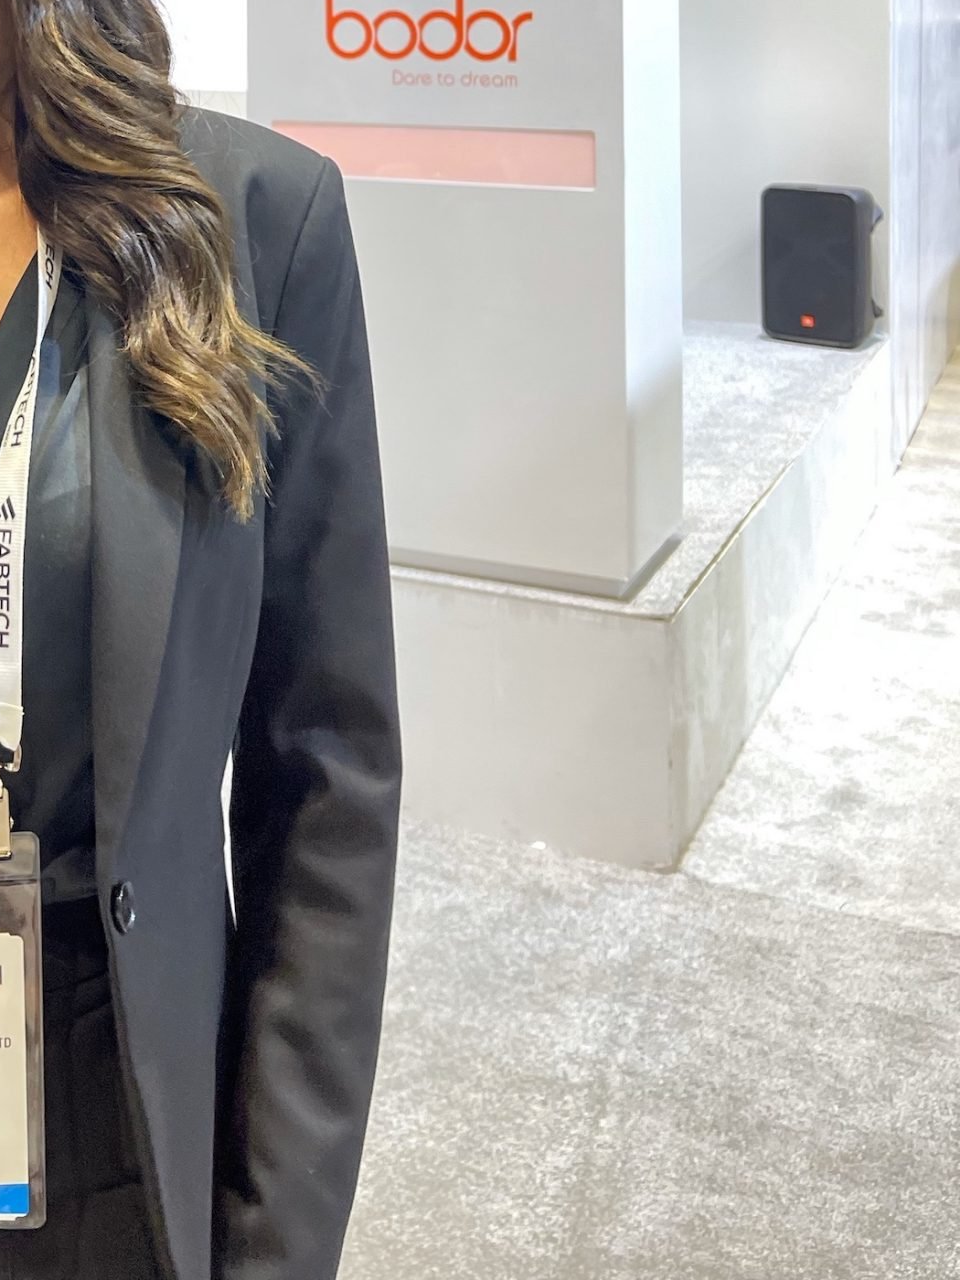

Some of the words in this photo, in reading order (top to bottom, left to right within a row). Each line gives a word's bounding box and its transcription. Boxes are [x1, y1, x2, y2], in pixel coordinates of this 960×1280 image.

[392, 69, 432, 86] Dare
[437, 70, 456, 87] to
[460, 70, 518, 88] dream
